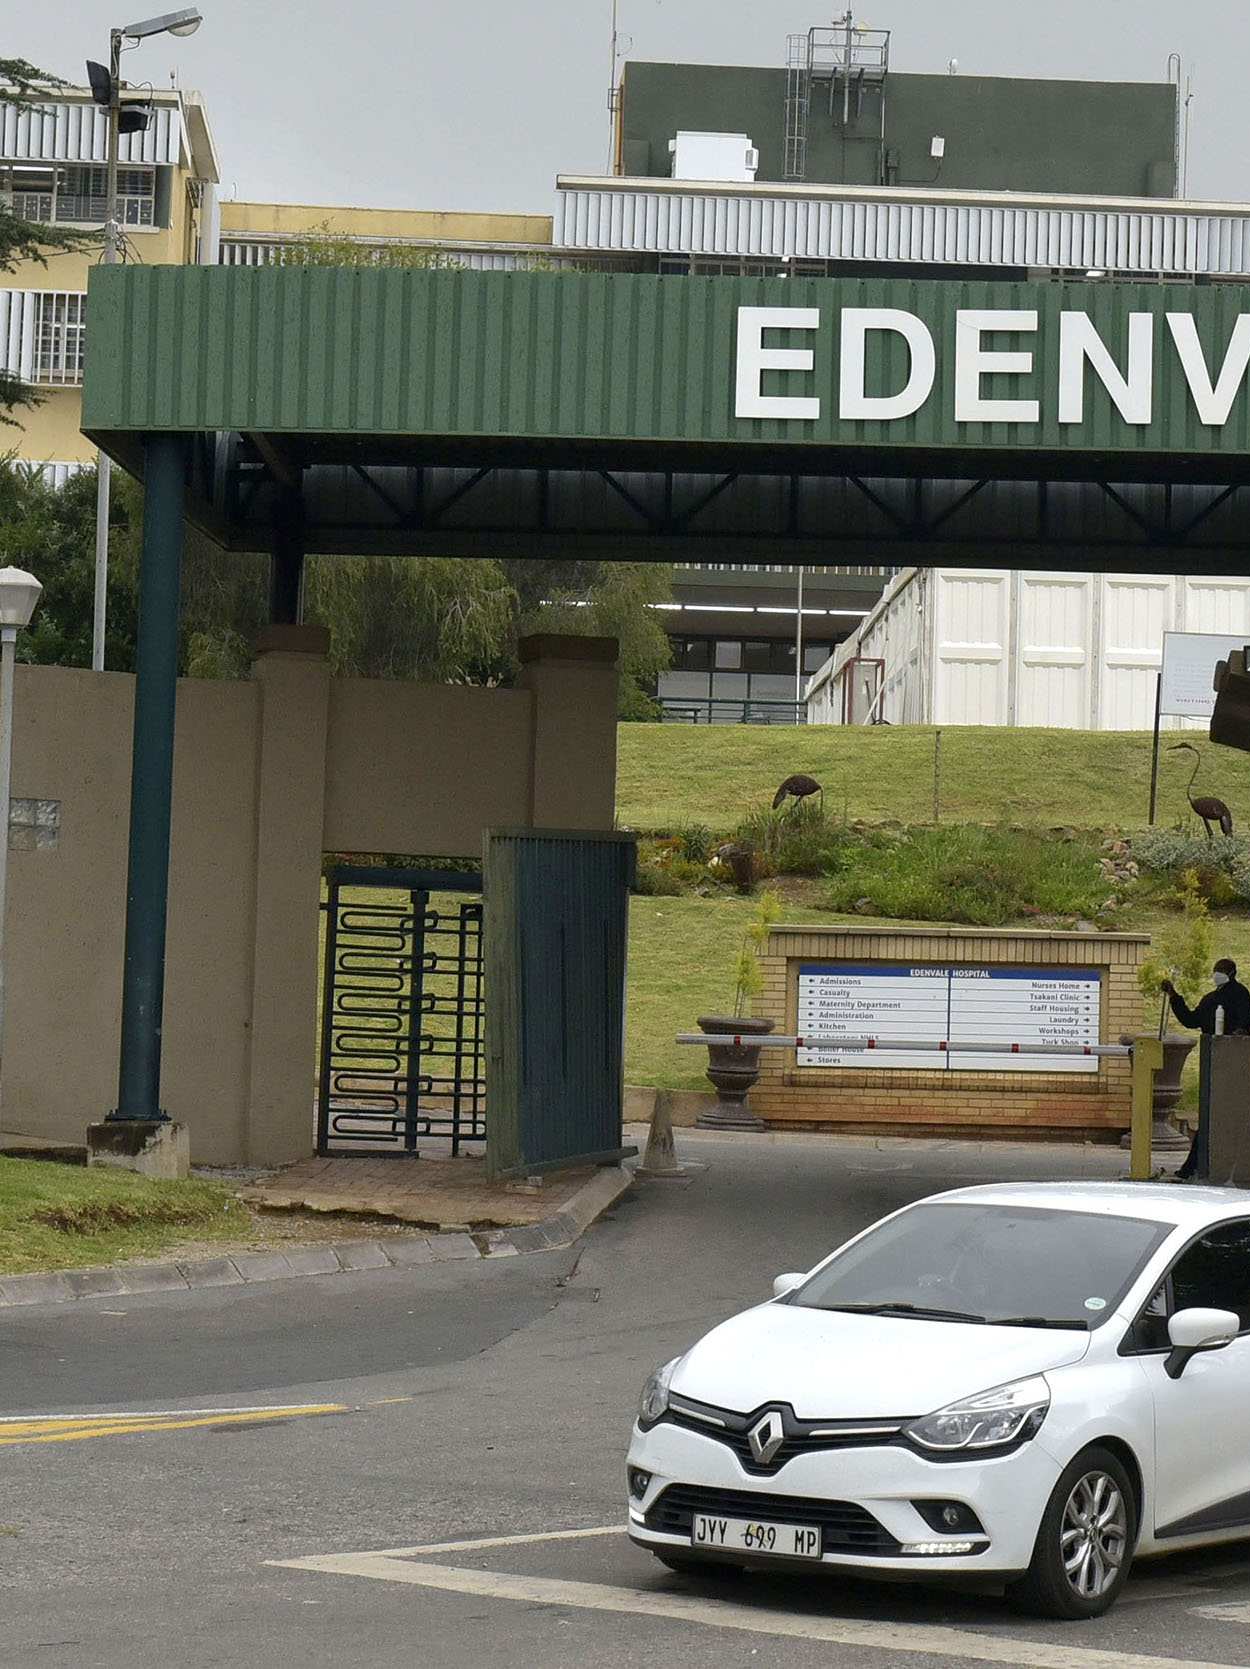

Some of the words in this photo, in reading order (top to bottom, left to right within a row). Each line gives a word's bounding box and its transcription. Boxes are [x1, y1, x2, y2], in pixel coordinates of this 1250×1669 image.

[910, 969, 949, 977] EDENVALE
[953, 969, 990, 978] HOSPITAL
[819, 977, 861, 985] Admissions
[819, 989, 851, 998] Casualty
[1060, 993, 1081, 1001] Clinic
[819, 1000, 855, 1009] Maternity
[857, 1001, 901, 1010] Department
[1029, 1004, 1048, 1012] Staff
[1049, 1005, 1080, 1015] Housing
[819, 1012, 874, 1020] Administration
[1049, 1016, 1079, 1026] Laundry
[818, 1022, 847, 1030] Kitchen
[1039, 1027, 1079, 1037] Workshops
[817, 1056, 841, 1064] Stores
[697, 1518, 728, 1544] JYY
[744, 1523, 777, 1550] 699
[794, 1529, 817, 1554] MP
